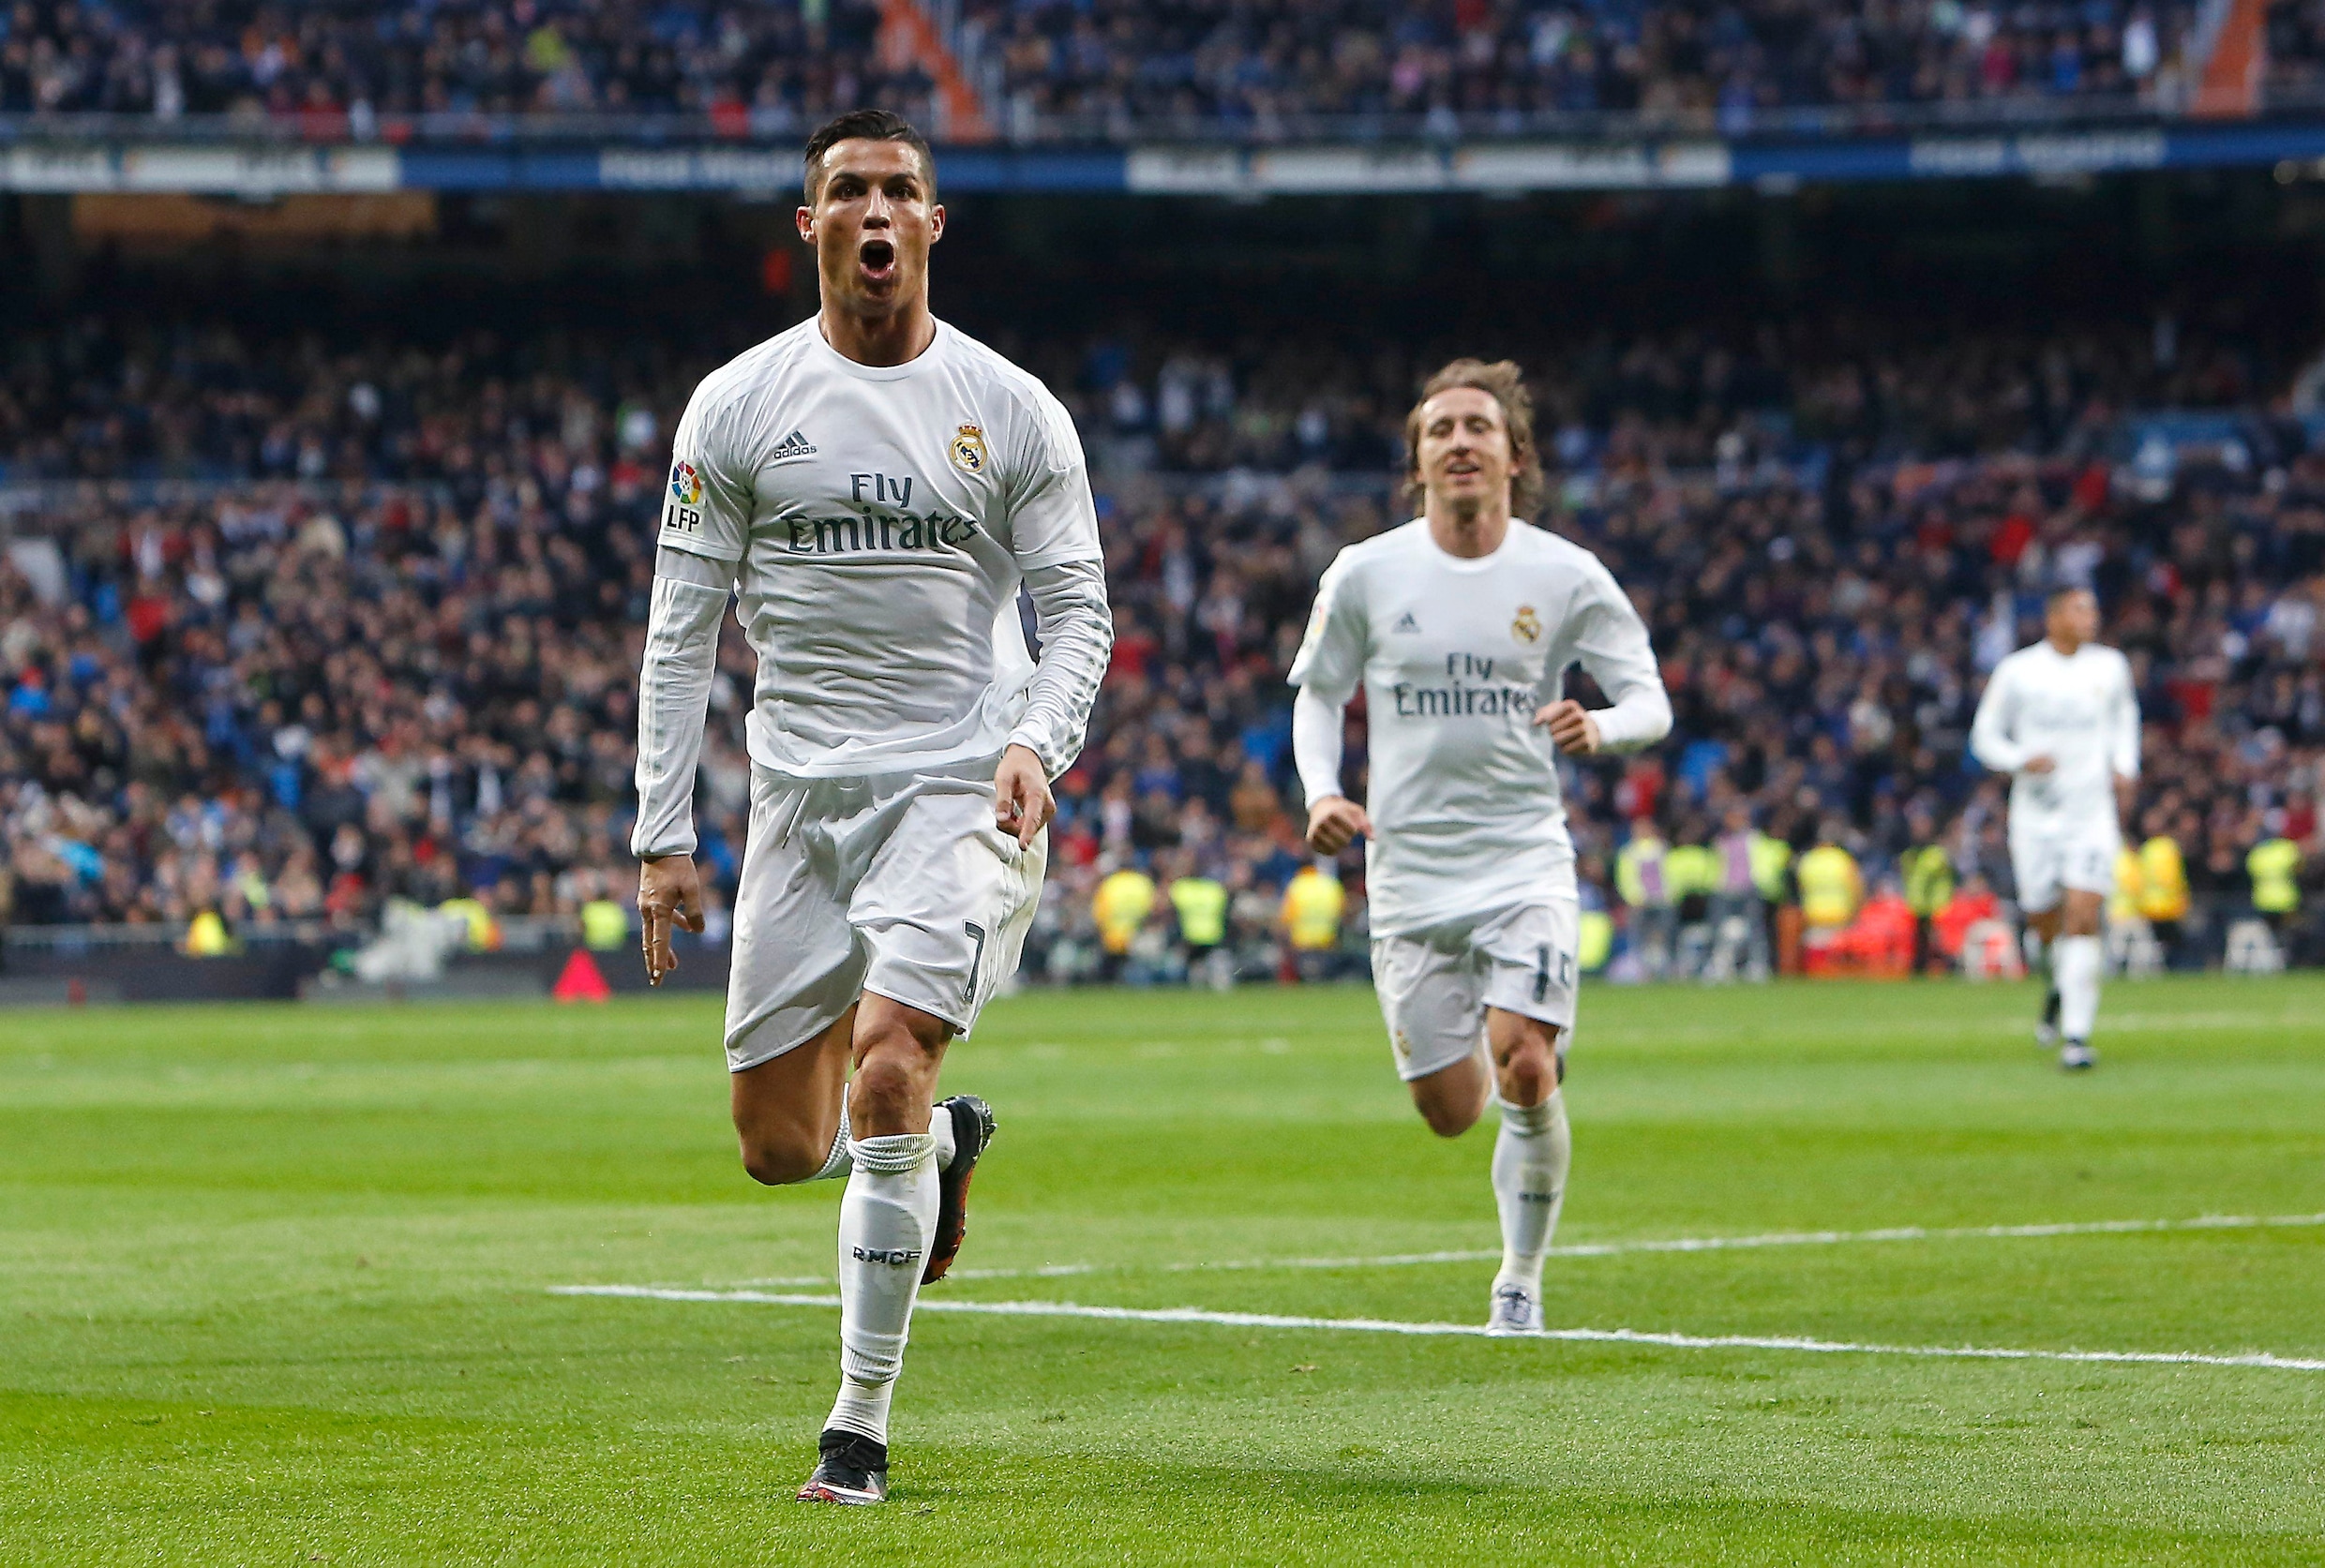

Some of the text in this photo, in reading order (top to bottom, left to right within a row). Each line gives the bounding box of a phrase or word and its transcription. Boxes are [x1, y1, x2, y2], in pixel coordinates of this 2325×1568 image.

[773, 444, 818, 459] adidas
[850, 473, 912, 508] Fly
[667, 504, 699, 532] LFP
[780, 506, 979, 553] Emirates
[1446, 652, 1493, 680] Fly
[963, 919, 985, 1004] 7
